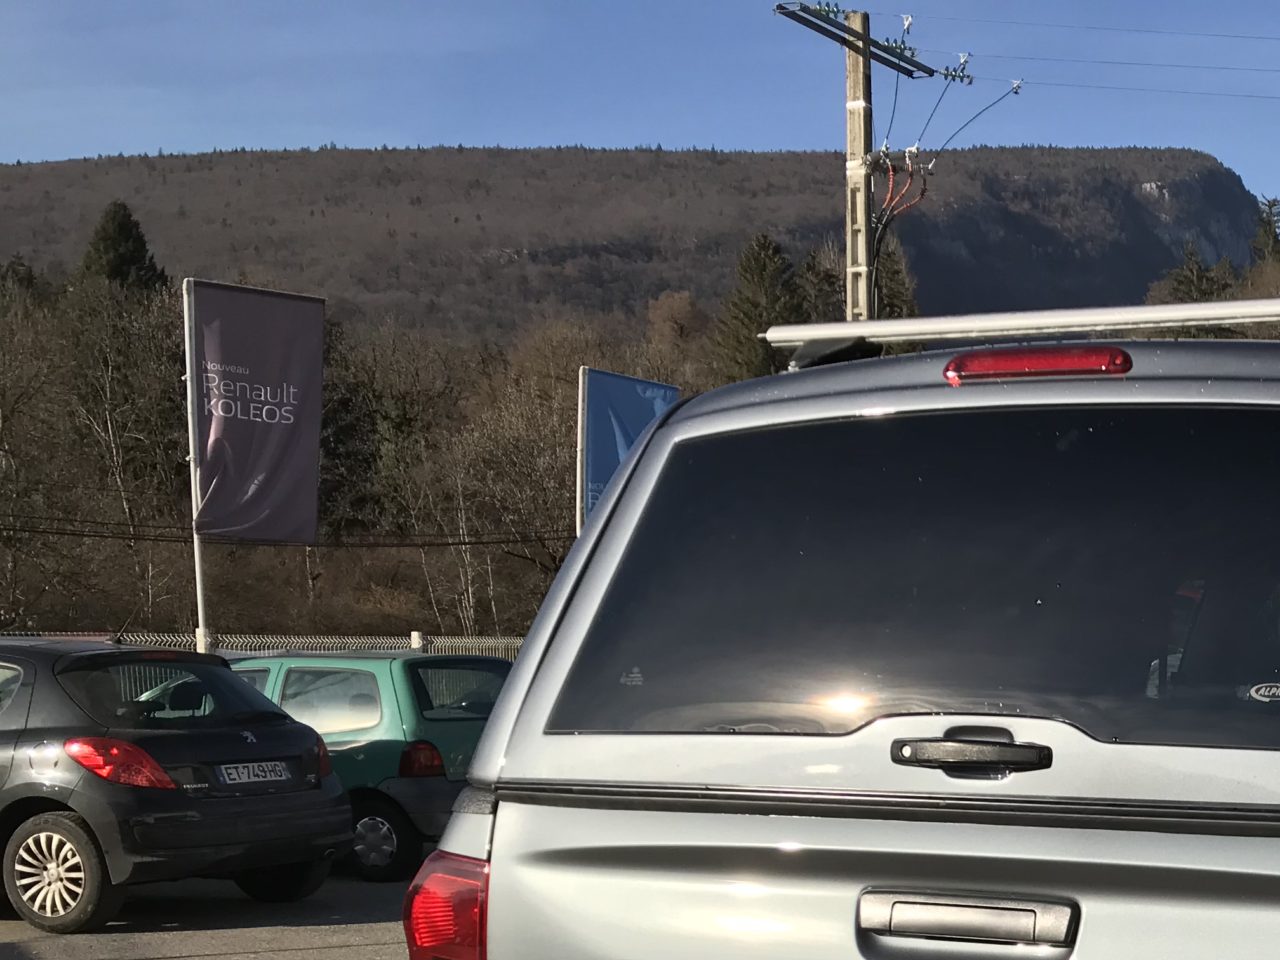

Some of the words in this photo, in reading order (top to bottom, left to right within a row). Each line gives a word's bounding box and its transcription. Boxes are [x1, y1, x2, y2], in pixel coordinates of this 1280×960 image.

[202, 360, 250, 374] Nouveau
[203, 373, 298, 404] Renault
[203, 397, 295, 424] KOLEOS
